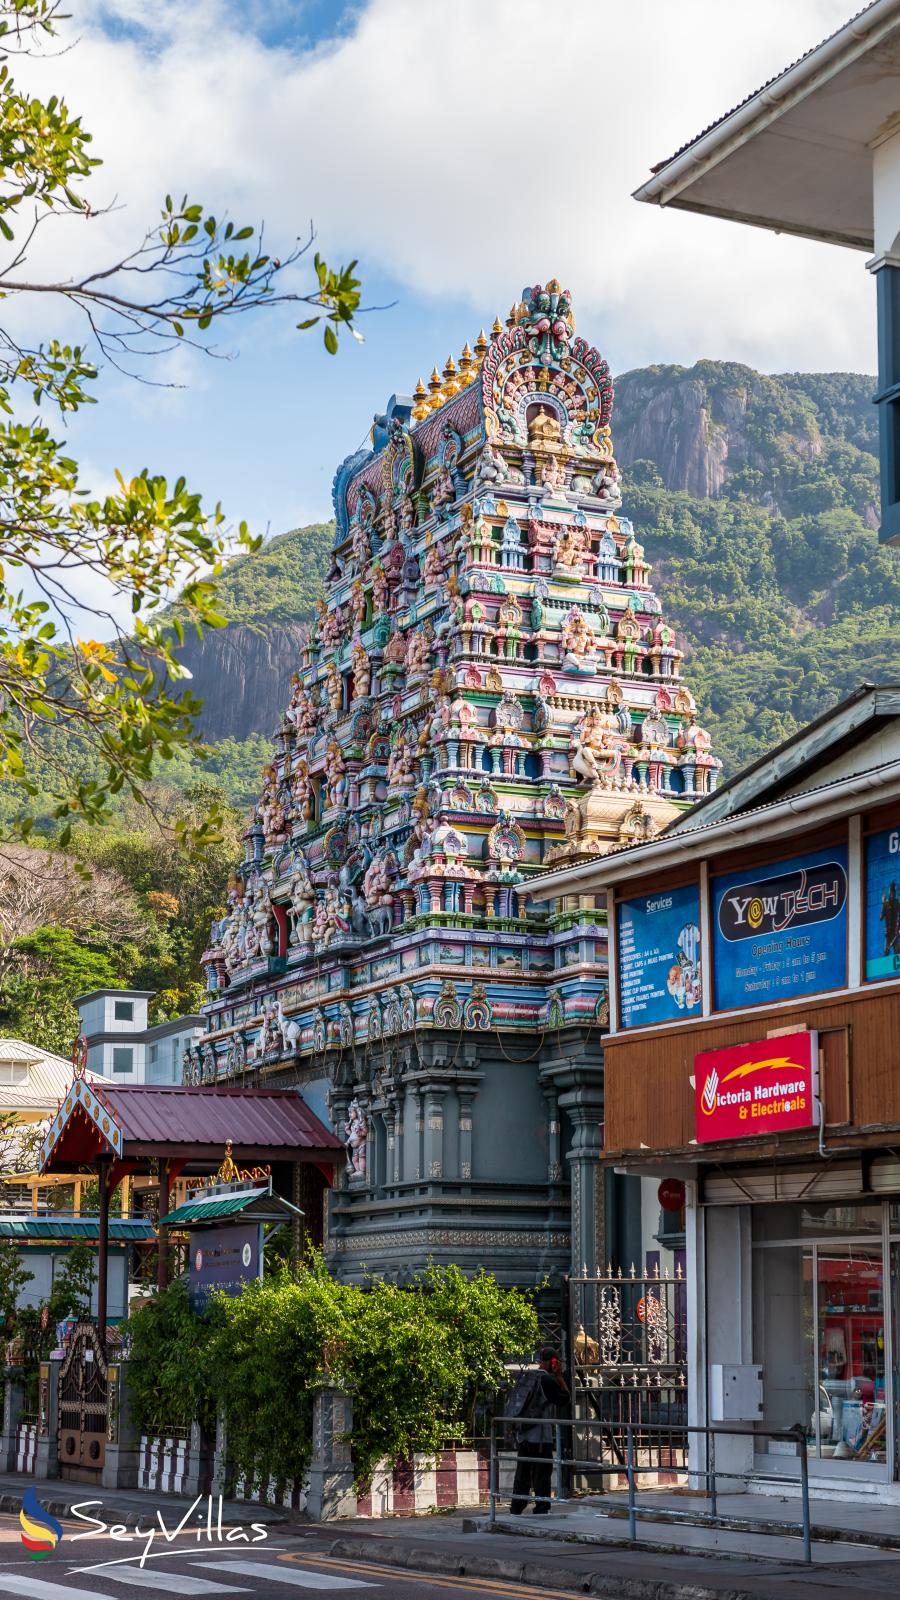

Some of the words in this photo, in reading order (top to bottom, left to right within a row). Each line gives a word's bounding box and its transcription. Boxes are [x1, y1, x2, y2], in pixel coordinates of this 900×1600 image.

[646, 897, 673, 913] Services
[752, 942, 784, 958] Opening
[786, 936, 811, 948] Hours
[702, 1068, 752, 1110] Victoria
[754, 1080, 806, 1100] Hardware
[739, 1105, 749, 1120] &
